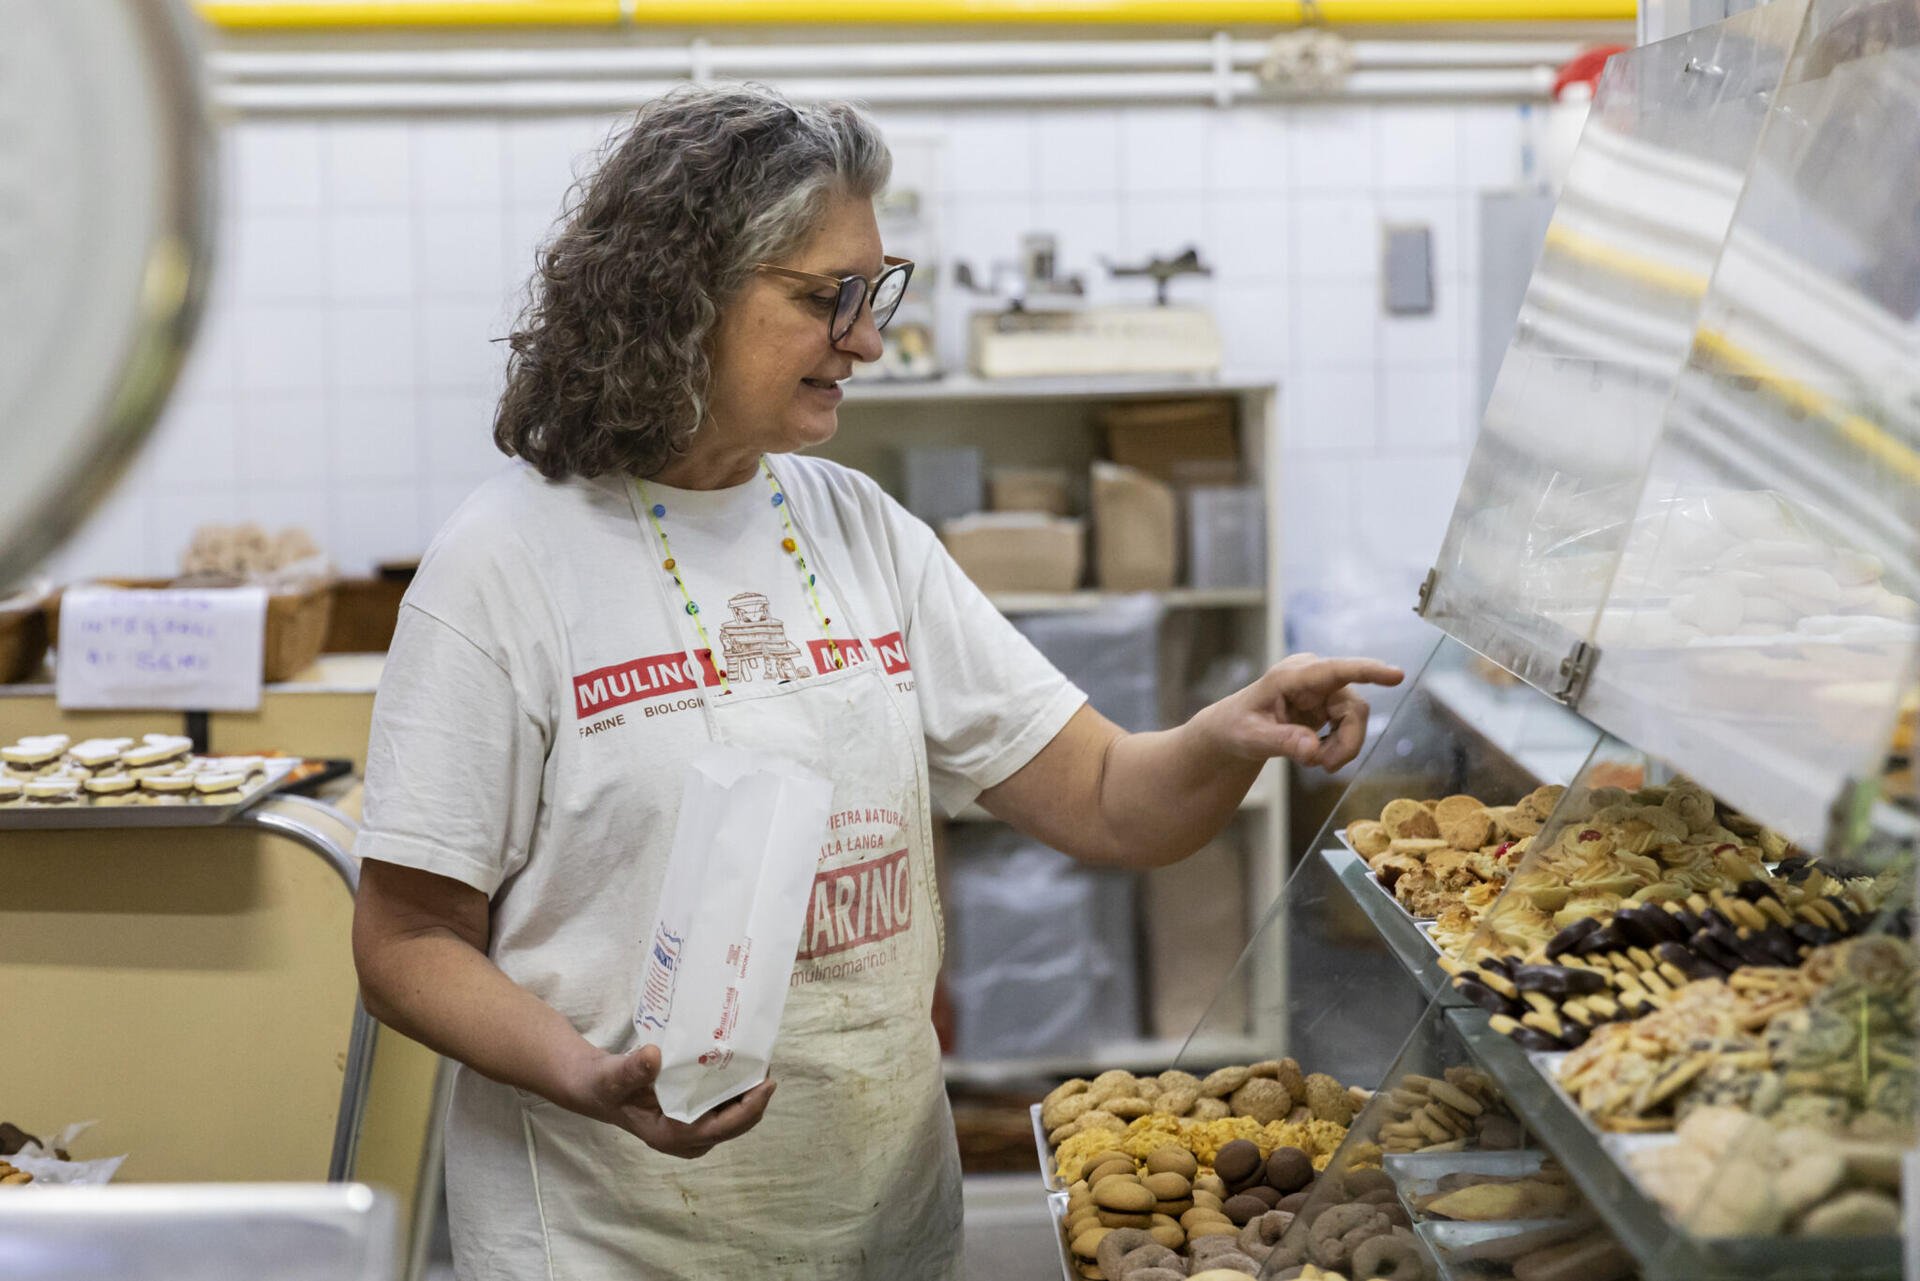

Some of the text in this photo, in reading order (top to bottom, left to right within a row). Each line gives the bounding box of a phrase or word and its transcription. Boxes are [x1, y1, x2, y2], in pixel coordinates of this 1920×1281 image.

[579, 714, 626, 738] FARINE
[644, 697, 705, 718] BIOLOGI
[826, 810, 862, 830] IETRA
[847, 834, 884, 852] LANGA
[798, 856, 911, 953] ARINO
[790, 944, 897, 987] mulinomarino.it
